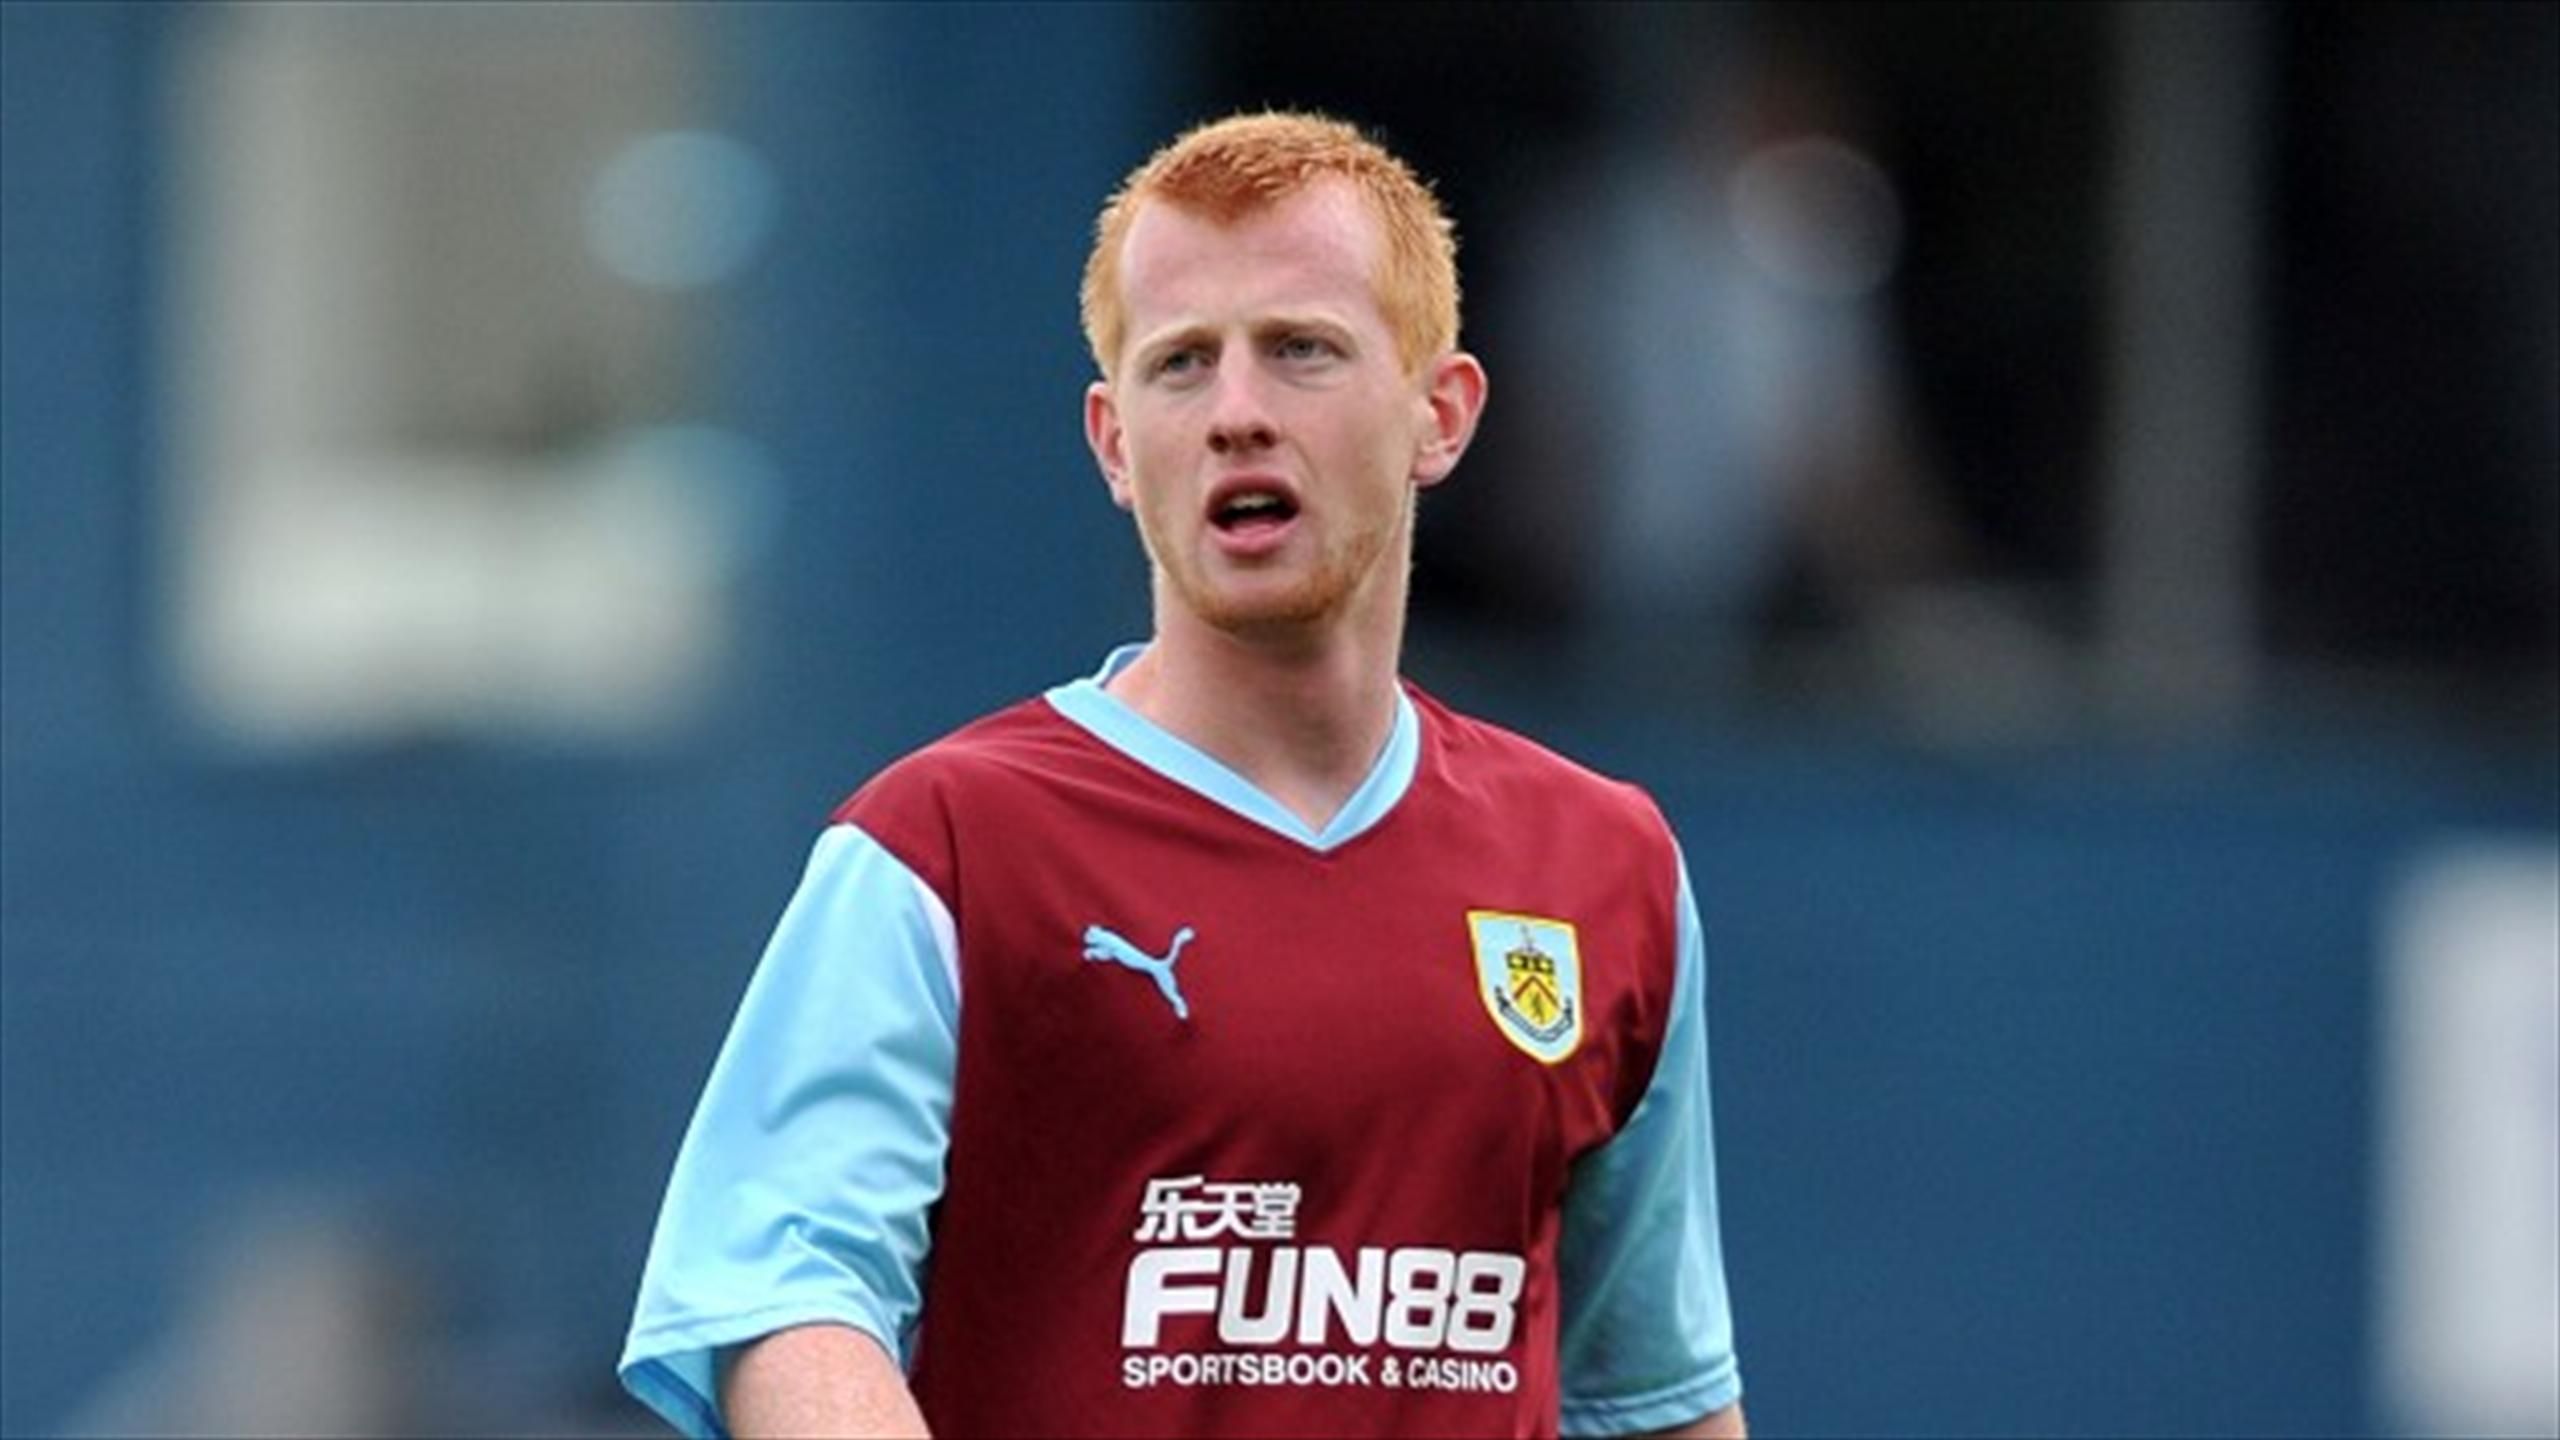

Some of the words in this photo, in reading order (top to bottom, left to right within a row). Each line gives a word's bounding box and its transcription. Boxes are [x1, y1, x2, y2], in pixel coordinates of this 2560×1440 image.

[1134, 1175, 1301, 1241] 乐天堂
[1121, 1246, 1526, 1353] FUN88
[1122, 1354, 1371, 1388] SPORTSBOOK
[1381, 1357, 1402, 1387] &
[1407, 1356, 1518, 1393] CASINO
